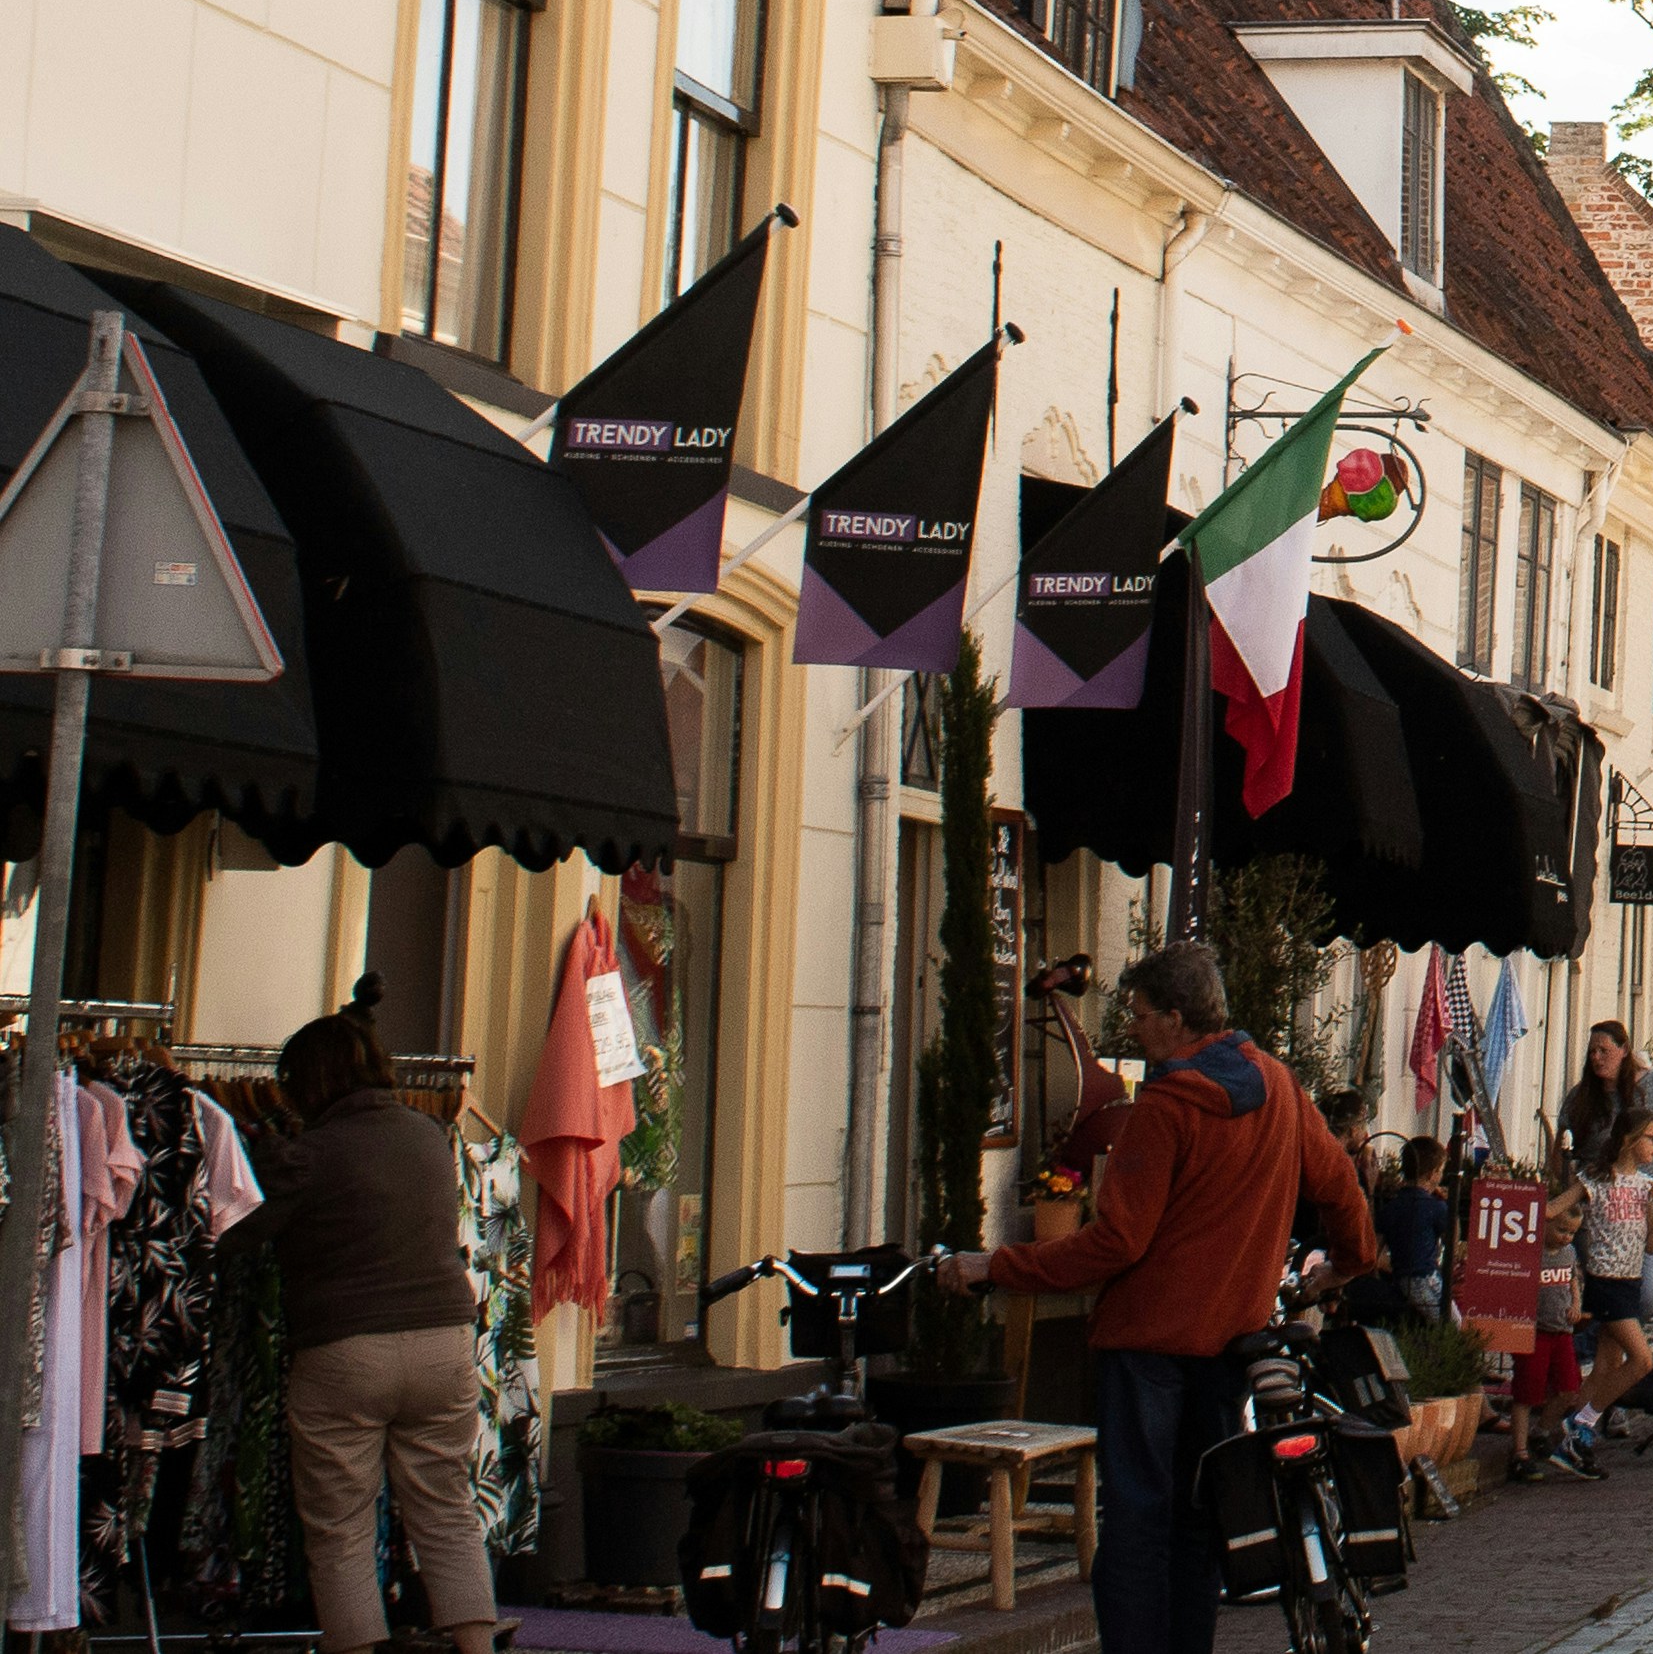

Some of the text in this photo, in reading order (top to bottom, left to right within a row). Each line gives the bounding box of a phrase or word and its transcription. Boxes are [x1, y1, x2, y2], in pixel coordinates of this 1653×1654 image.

[574, 422, 732, 447] TRENDY LADY
[826, 514, 971, 541] TRENDY LADY
[1034, 574, 1156, 594] TRENDY LADY
[1477, 1197, 1539, 1249] ijs!
